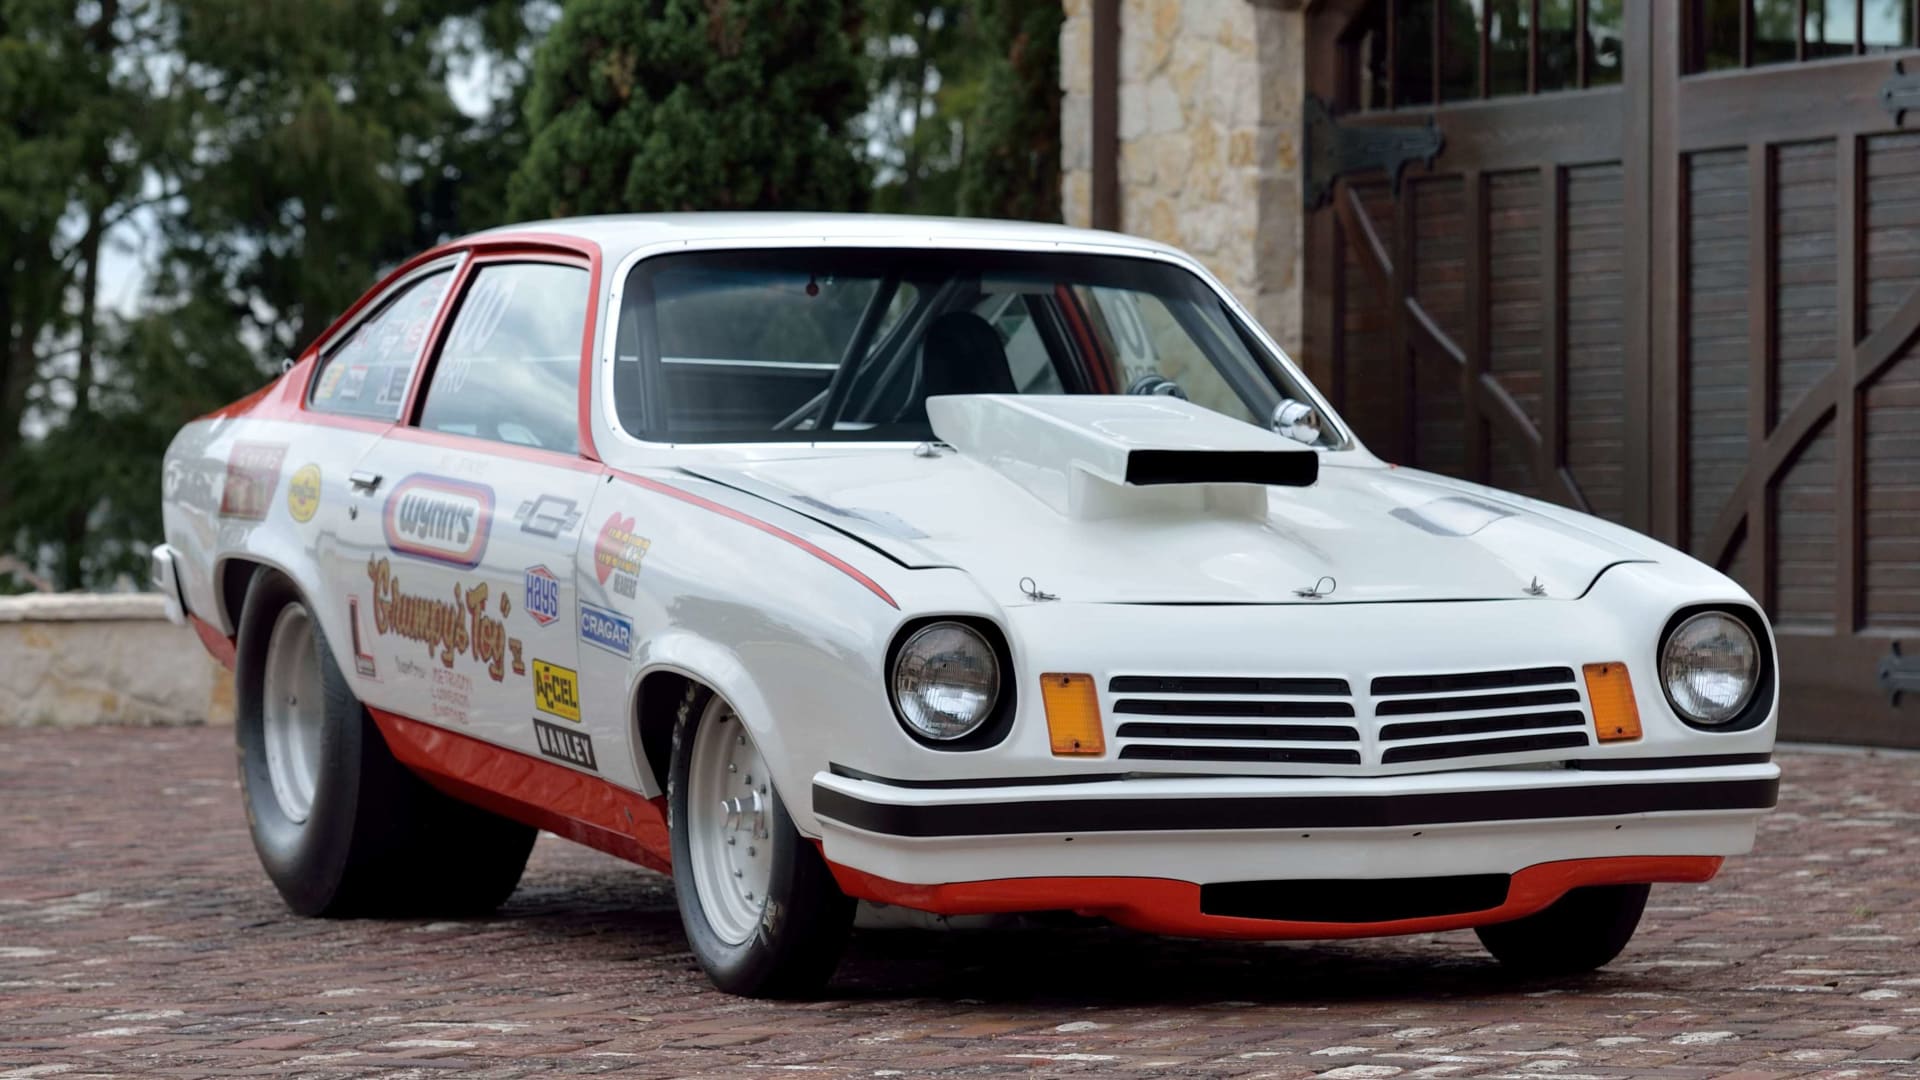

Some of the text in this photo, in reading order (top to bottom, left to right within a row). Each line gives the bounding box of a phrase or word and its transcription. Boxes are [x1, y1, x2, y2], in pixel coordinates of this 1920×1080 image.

[582, 612, 631, 647] CRAGAR
[535, 665, 578, 710] ACCEL
[536, 723, 593, 765] MANLEY
